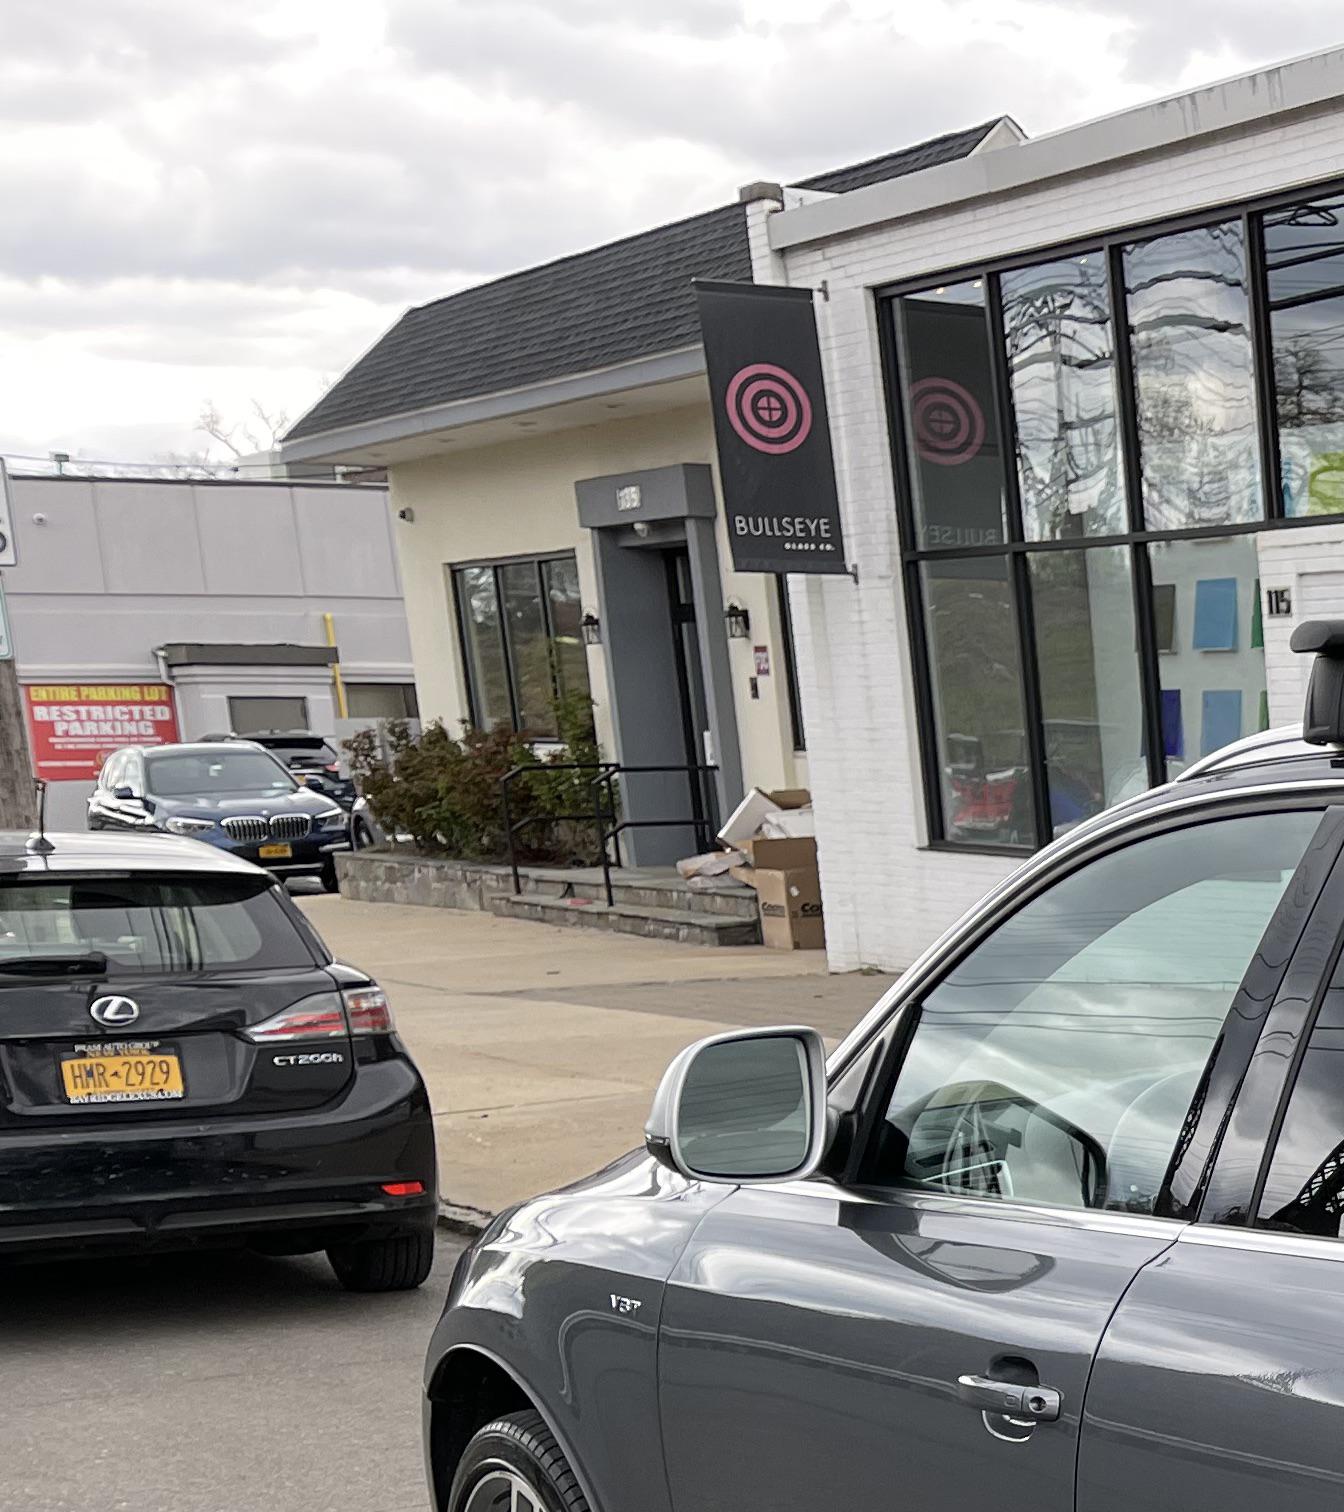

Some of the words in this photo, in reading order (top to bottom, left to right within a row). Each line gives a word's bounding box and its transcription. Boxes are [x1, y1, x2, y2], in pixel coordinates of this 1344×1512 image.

[734, 515, 832, 538] BULLSEYE
[1267, 589, 1291, 614] 115
[29, 686, 78, 701] ENTIRE
[80, 686, 141, 701] PARKING
[143, 686, 169, 701] LOT
[32, 705, 171, 721] RESTRICTED
[53, 721, 155, 736] PARKING
[121, 1059, 170, 1087] 2929
